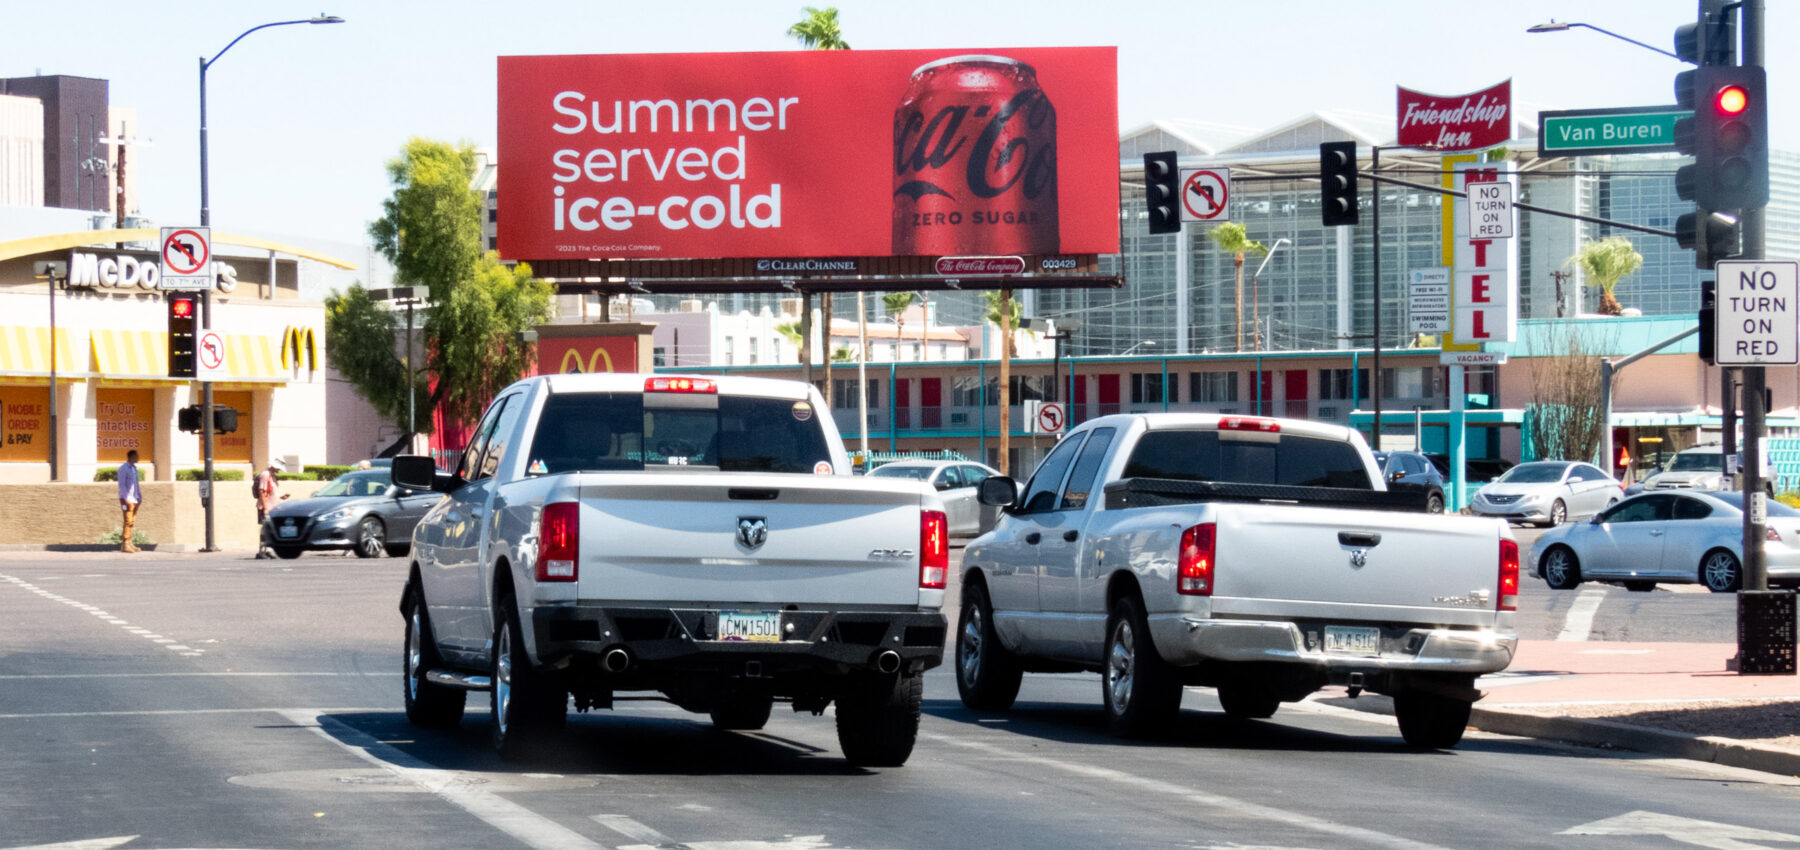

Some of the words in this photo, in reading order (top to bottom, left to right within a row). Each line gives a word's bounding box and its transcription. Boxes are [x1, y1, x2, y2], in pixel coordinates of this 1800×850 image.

[552, 90, 799, 134] Summer
[1400, 94, 1507, 129] Friendship
[1435, 125, 1472, 148] Inn
[1559, 125, 1596, 141] Van
[1602, 123, 1662, 140] Buren
[552, 135, 746, 182] served
[1480, 187, 1500, 198] NO
[553, 183, 781, 231] ice-cold
[1475, 201, 1506, 211] TURN
[912, 211, 963, 226] ZERO
[972, 210, 1040, 225] SUGAR
[1483, 213, 1499, 223] ON
[1480, 225, 1503, 235] RED
[578, 244, 591, 252] The
[1042, 259, 1077, 269] 003429
[166, 277, 175, 286] TO
[192, 276, 206, 285] AVE
[1740, 271, 1777, 291] NO
[1729, 297, 1786, 313] TURN
[1743, 318, 1772, 334] ON
[1736, 340, 1778, 356] RED
[1457, 355, 1495, 363] VACANCY
[8, 404, 42, 415] MOBILE
[100, 402, 115, 416] Try
[118, 402, 136, 415] Our
[8, 419, 39, 430] ORDER
[7, 434, 14, 444] &
[16, 434, 32, 445] PAY
[727, 619, 778, 636] CMW1501
